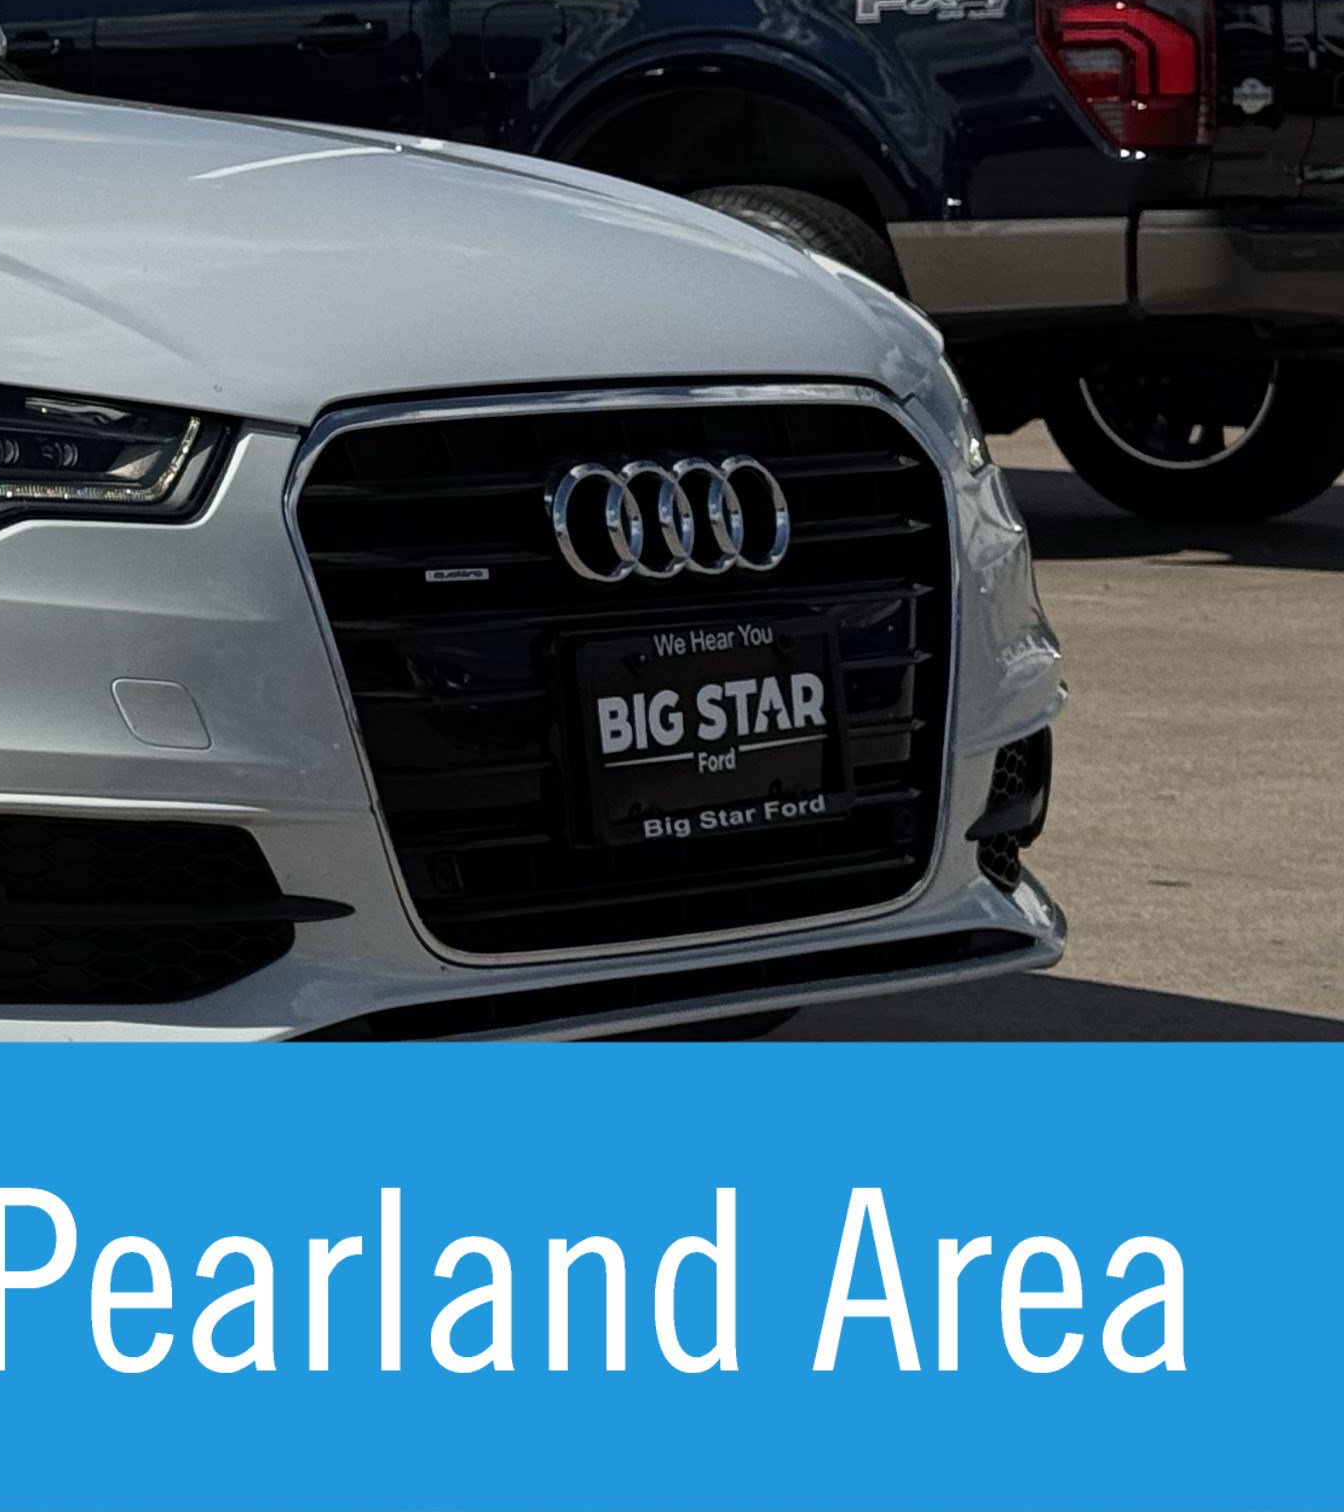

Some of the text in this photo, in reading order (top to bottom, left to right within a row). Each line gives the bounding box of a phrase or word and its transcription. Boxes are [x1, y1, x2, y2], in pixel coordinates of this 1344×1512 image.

[653, 624, 773, 657] We Hear You
[597, 673, 826, 754] BIG STAR
[698, 748, 736, 773] Ford
[643, 795, 826, 838] Big Star Ford
